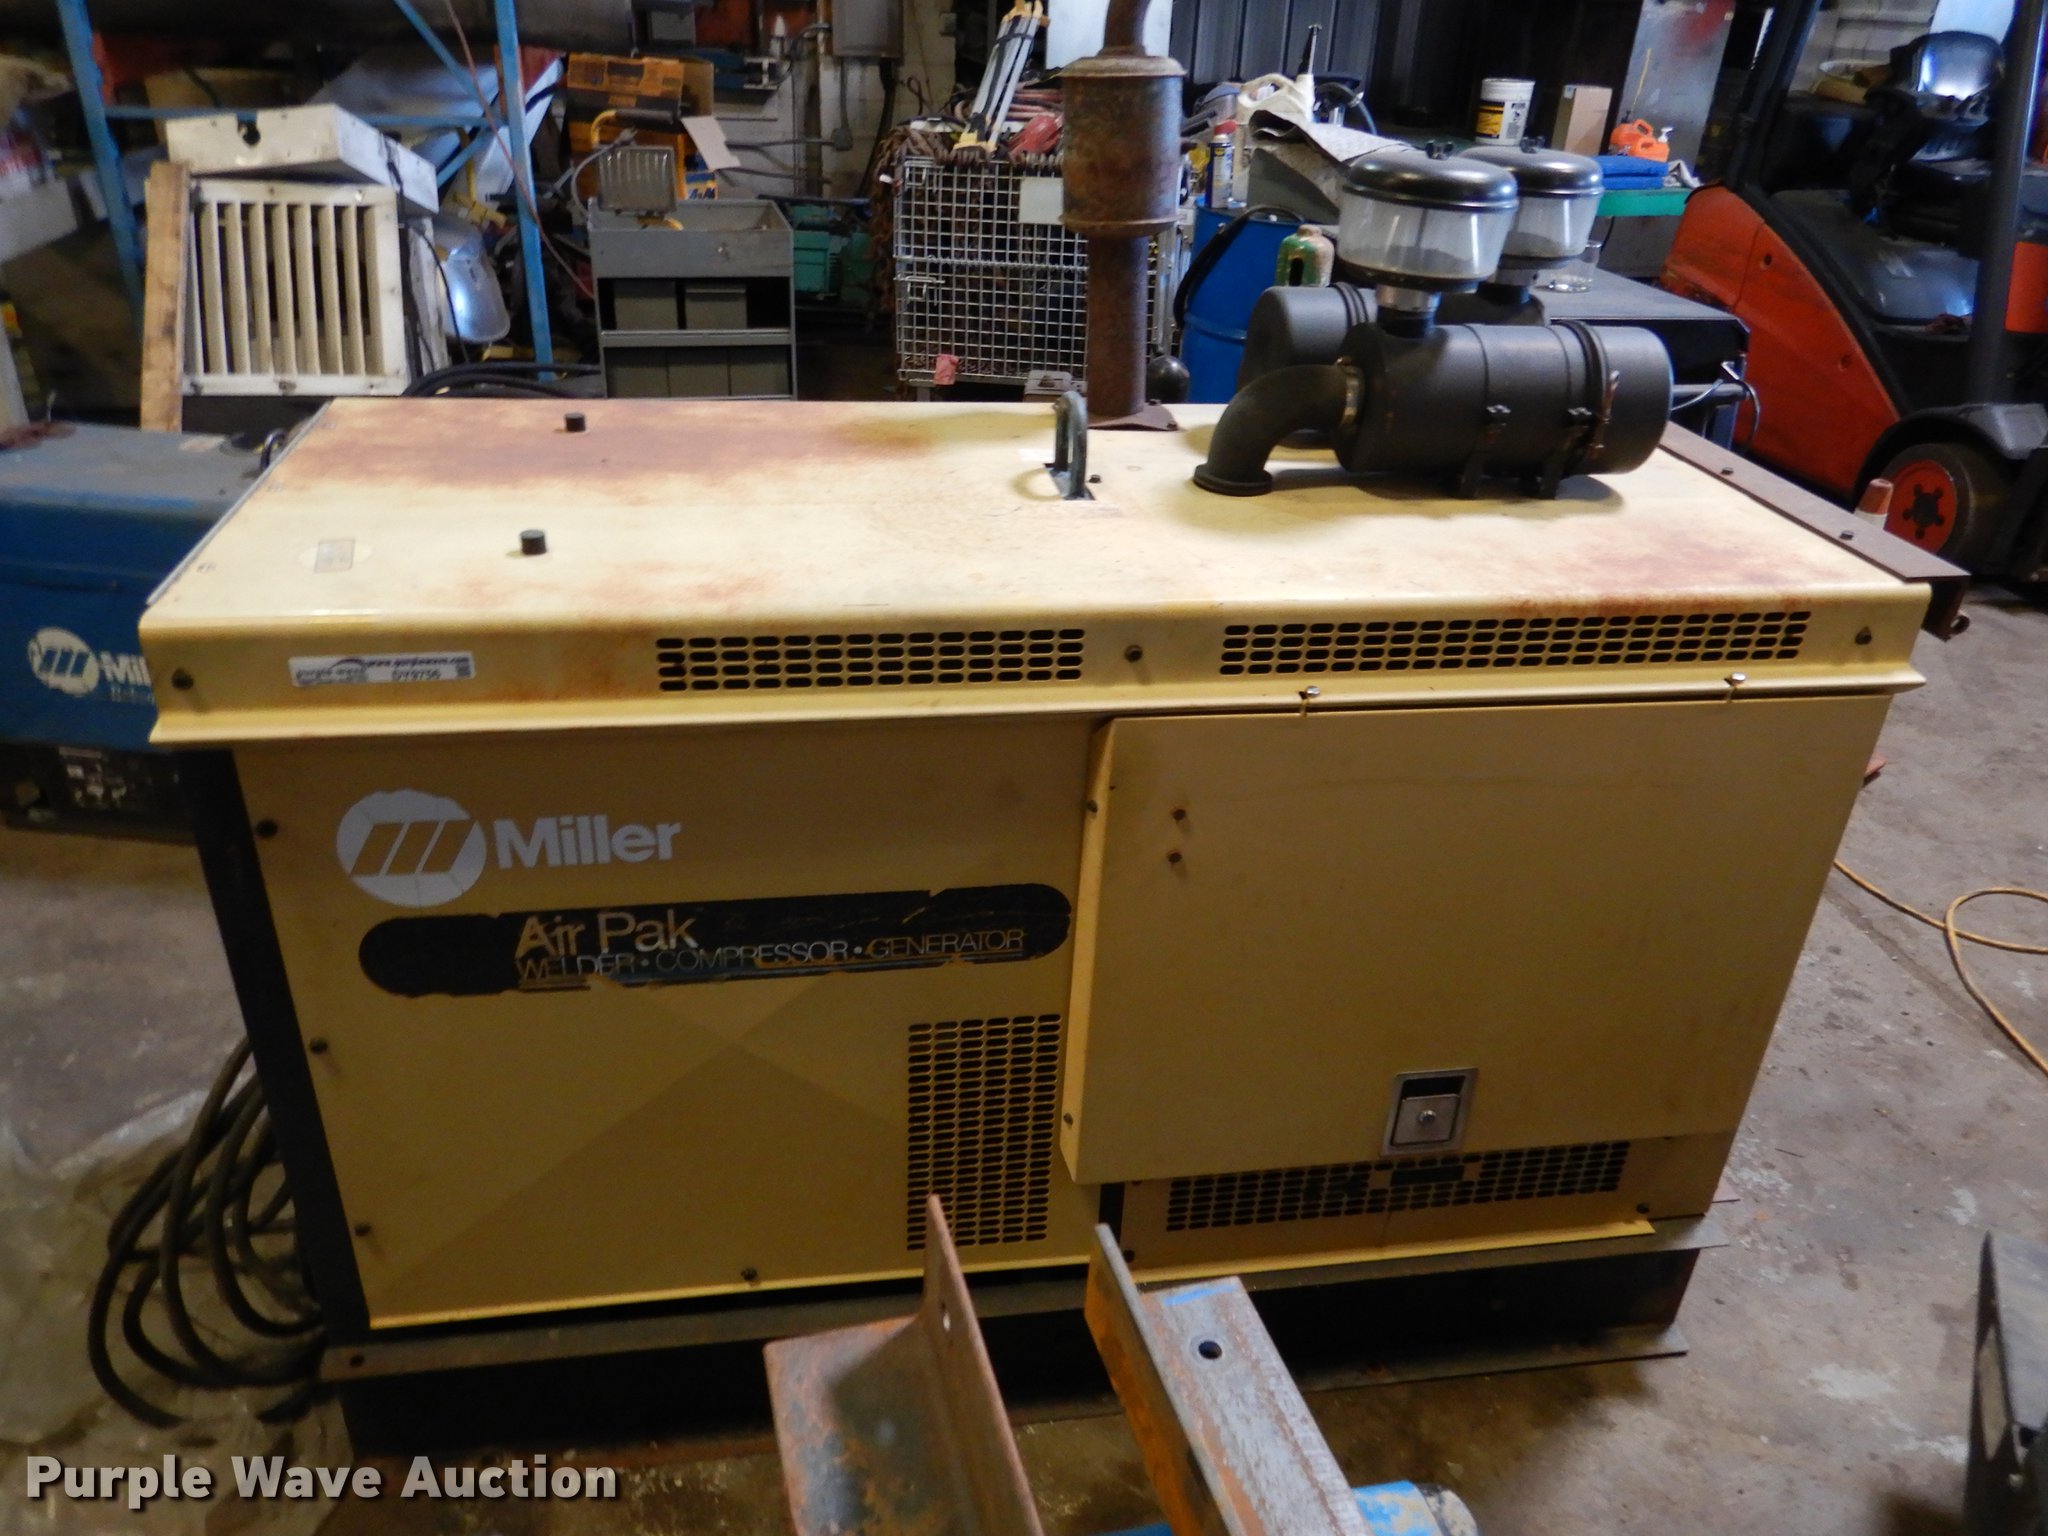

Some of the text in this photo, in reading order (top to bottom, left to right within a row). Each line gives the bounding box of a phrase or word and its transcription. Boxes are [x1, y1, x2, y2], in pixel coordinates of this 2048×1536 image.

[100, 651, 152, 687] Mil
[493, 814, 681, 869] Miller
[513, 908, 700, 959] Air Pak
[655, 939, 849, 973] COMPRESSOR
[869, 928, 1025, 961] GENERATOR
